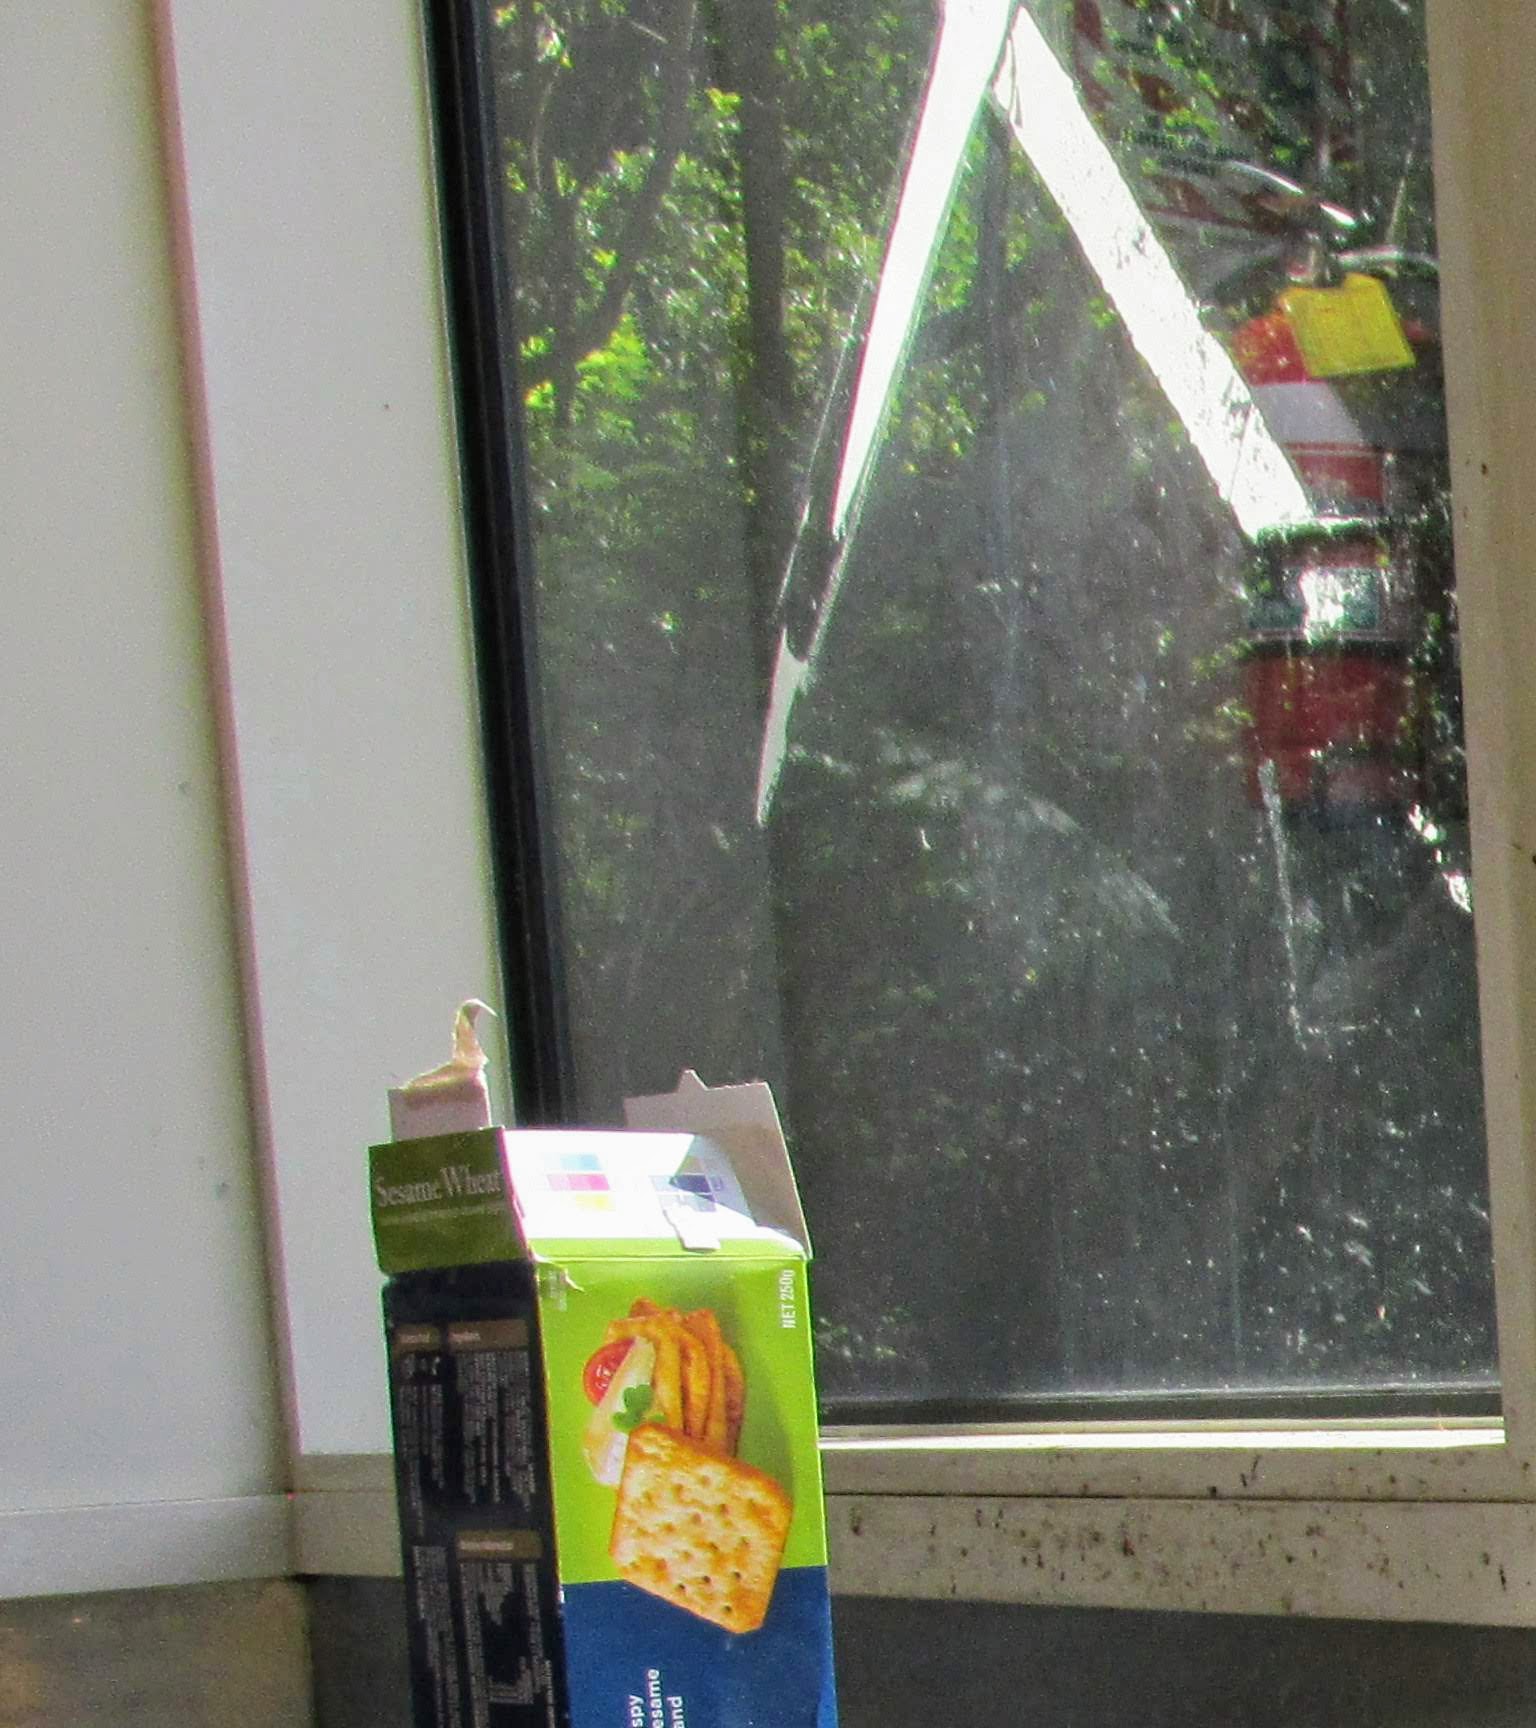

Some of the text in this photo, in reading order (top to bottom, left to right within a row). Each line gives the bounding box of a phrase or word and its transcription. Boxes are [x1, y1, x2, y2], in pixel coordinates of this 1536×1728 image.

[375, 1164, 502, 1207] Sesame Wheat
[780, 1303, 796, 1329] NET
